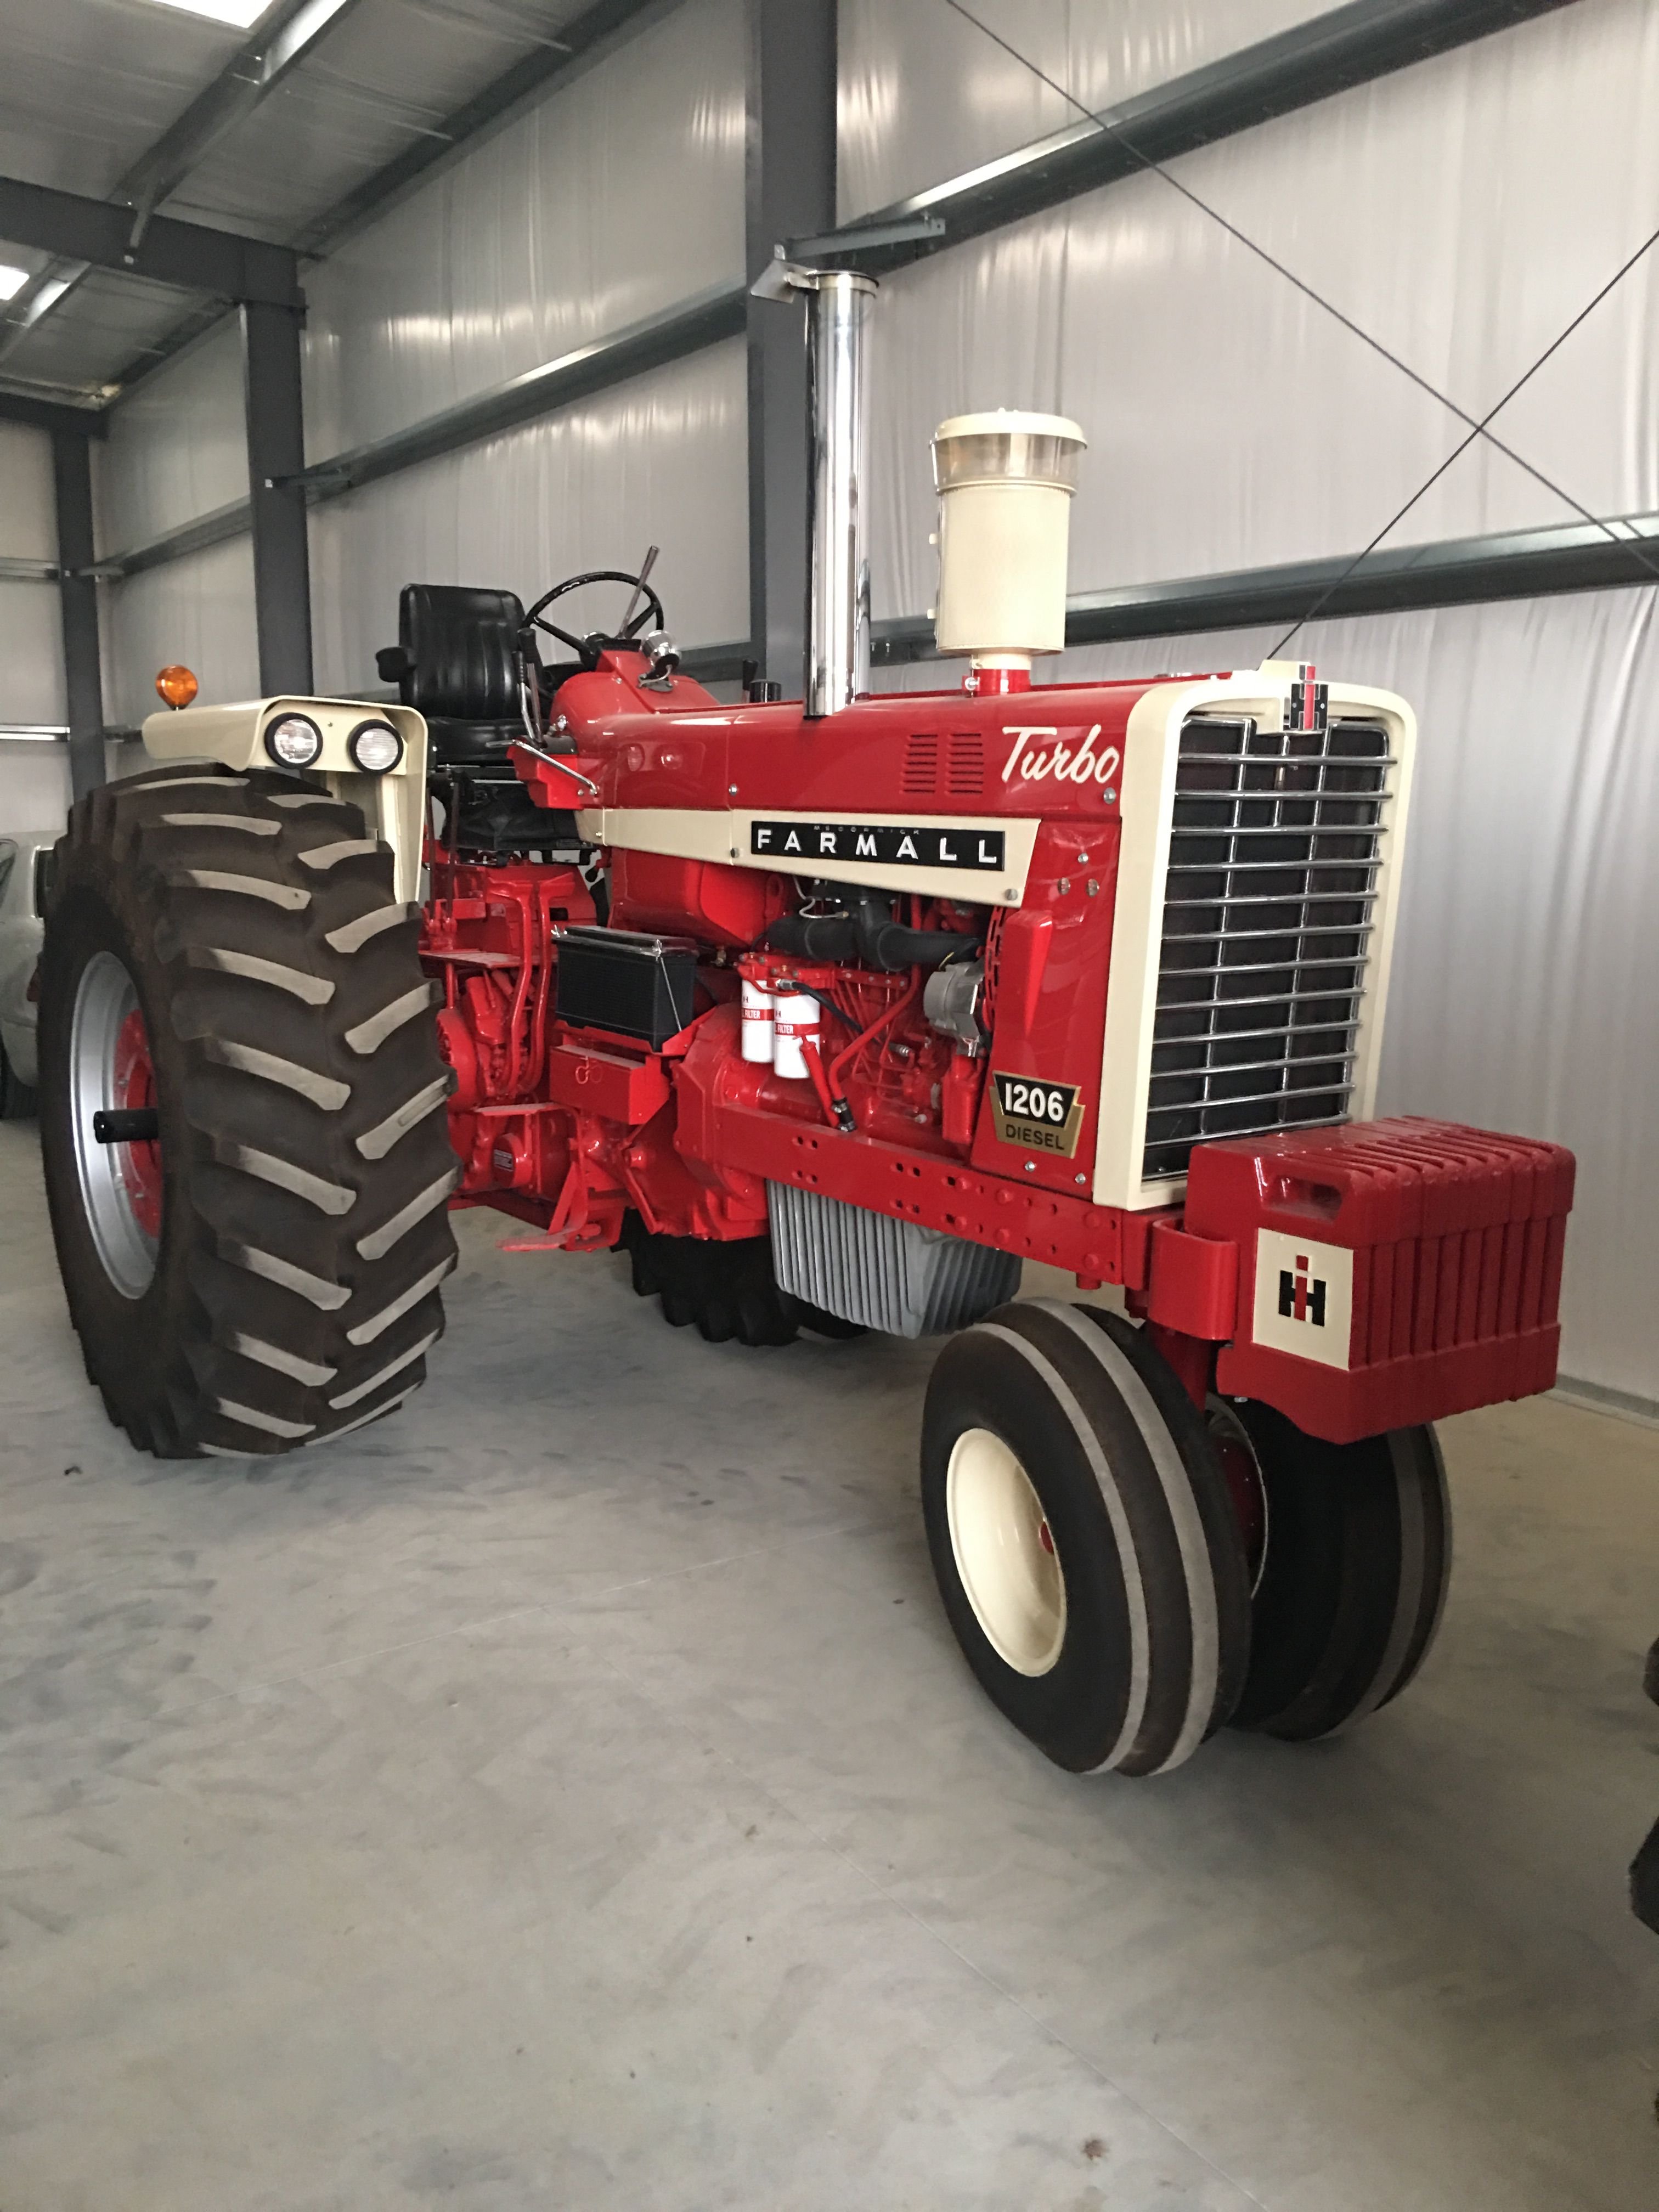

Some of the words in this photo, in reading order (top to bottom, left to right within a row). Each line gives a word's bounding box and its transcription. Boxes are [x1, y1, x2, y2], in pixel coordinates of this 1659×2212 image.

[1001, 724, 1120, 783] Turbo
[758, 829, 997, 863] FARMALL
[744, 1009, 760, 1019] FILTER
[777, 1025, 794, 1034] FILTER
[1005, 1082, 1064, 1121] 1206
[1006, 1124, 1064, 1150] DIESEL
